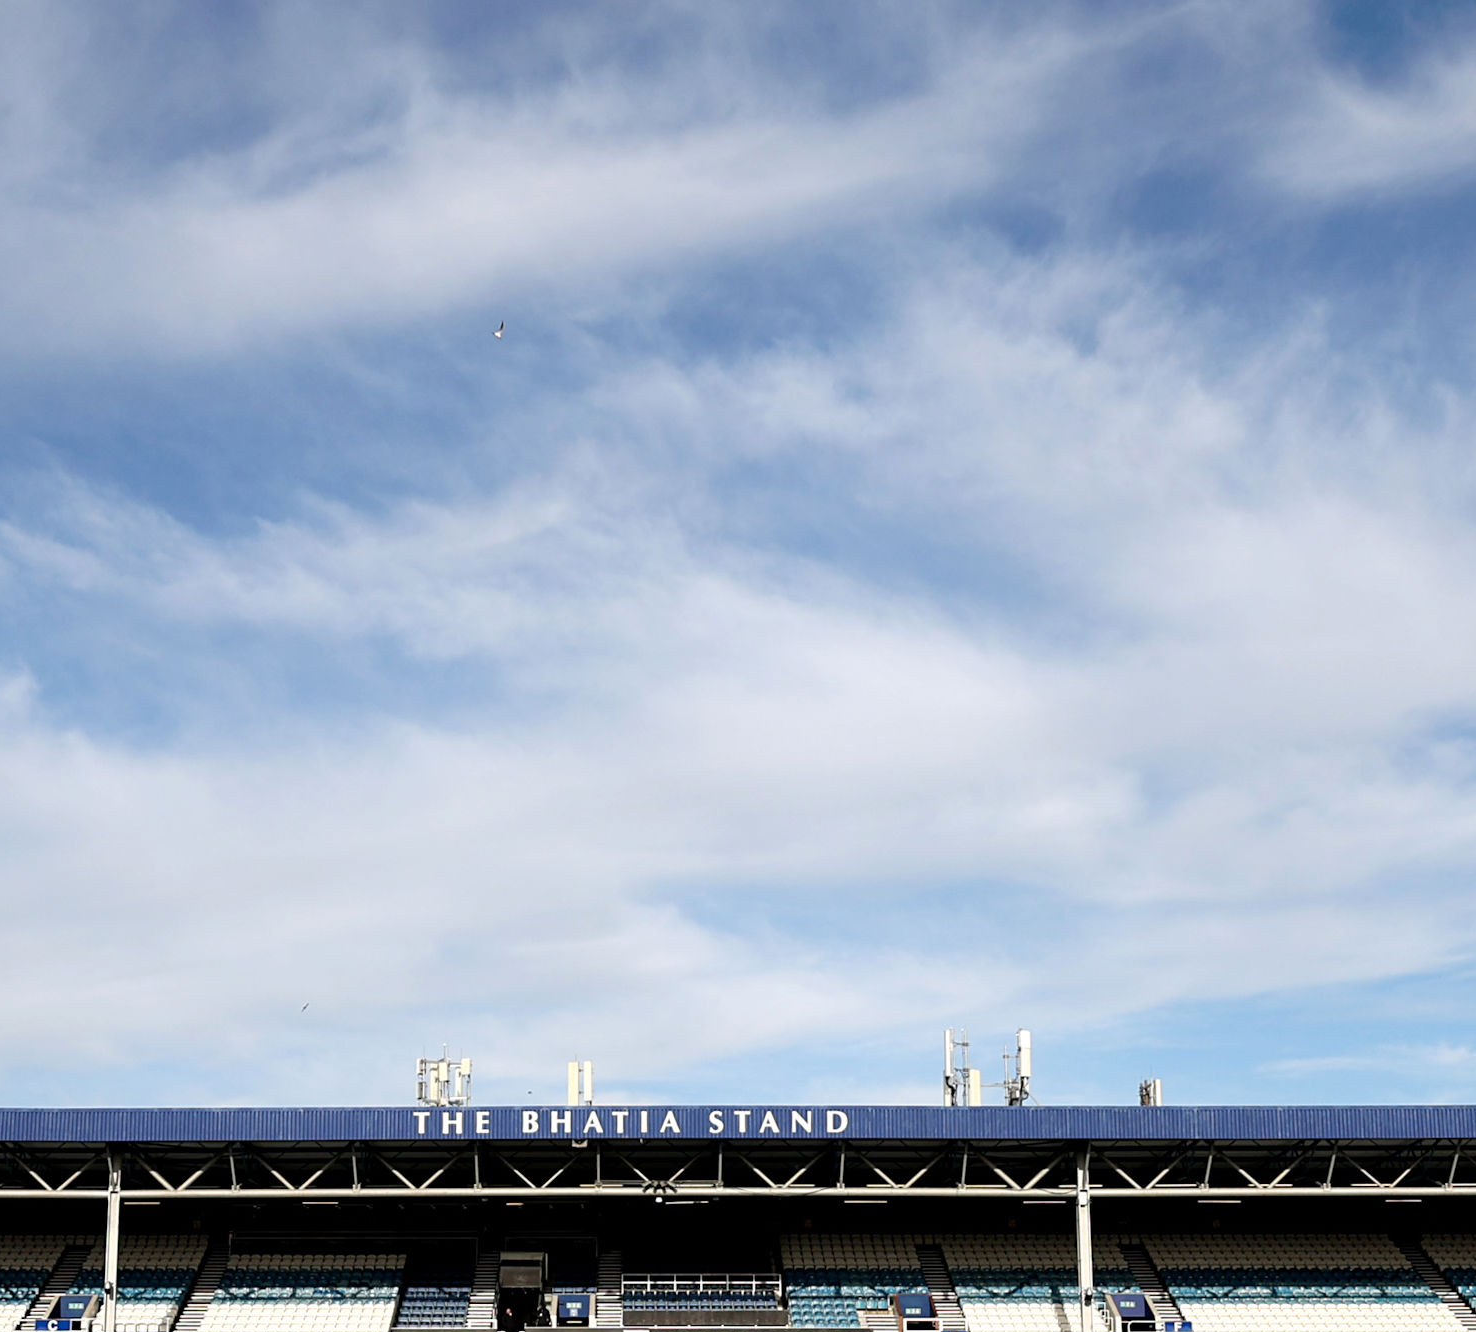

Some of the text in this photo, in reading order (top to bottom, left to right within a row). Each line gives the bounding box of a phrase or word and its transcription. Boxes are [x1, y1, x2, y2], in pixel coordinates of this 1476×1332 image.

[413, 1110, 849, 1134] THE BHATIA STAND
[47, 1319, 58, 1331] C
[1174, 1322, 1182, 1332] F
